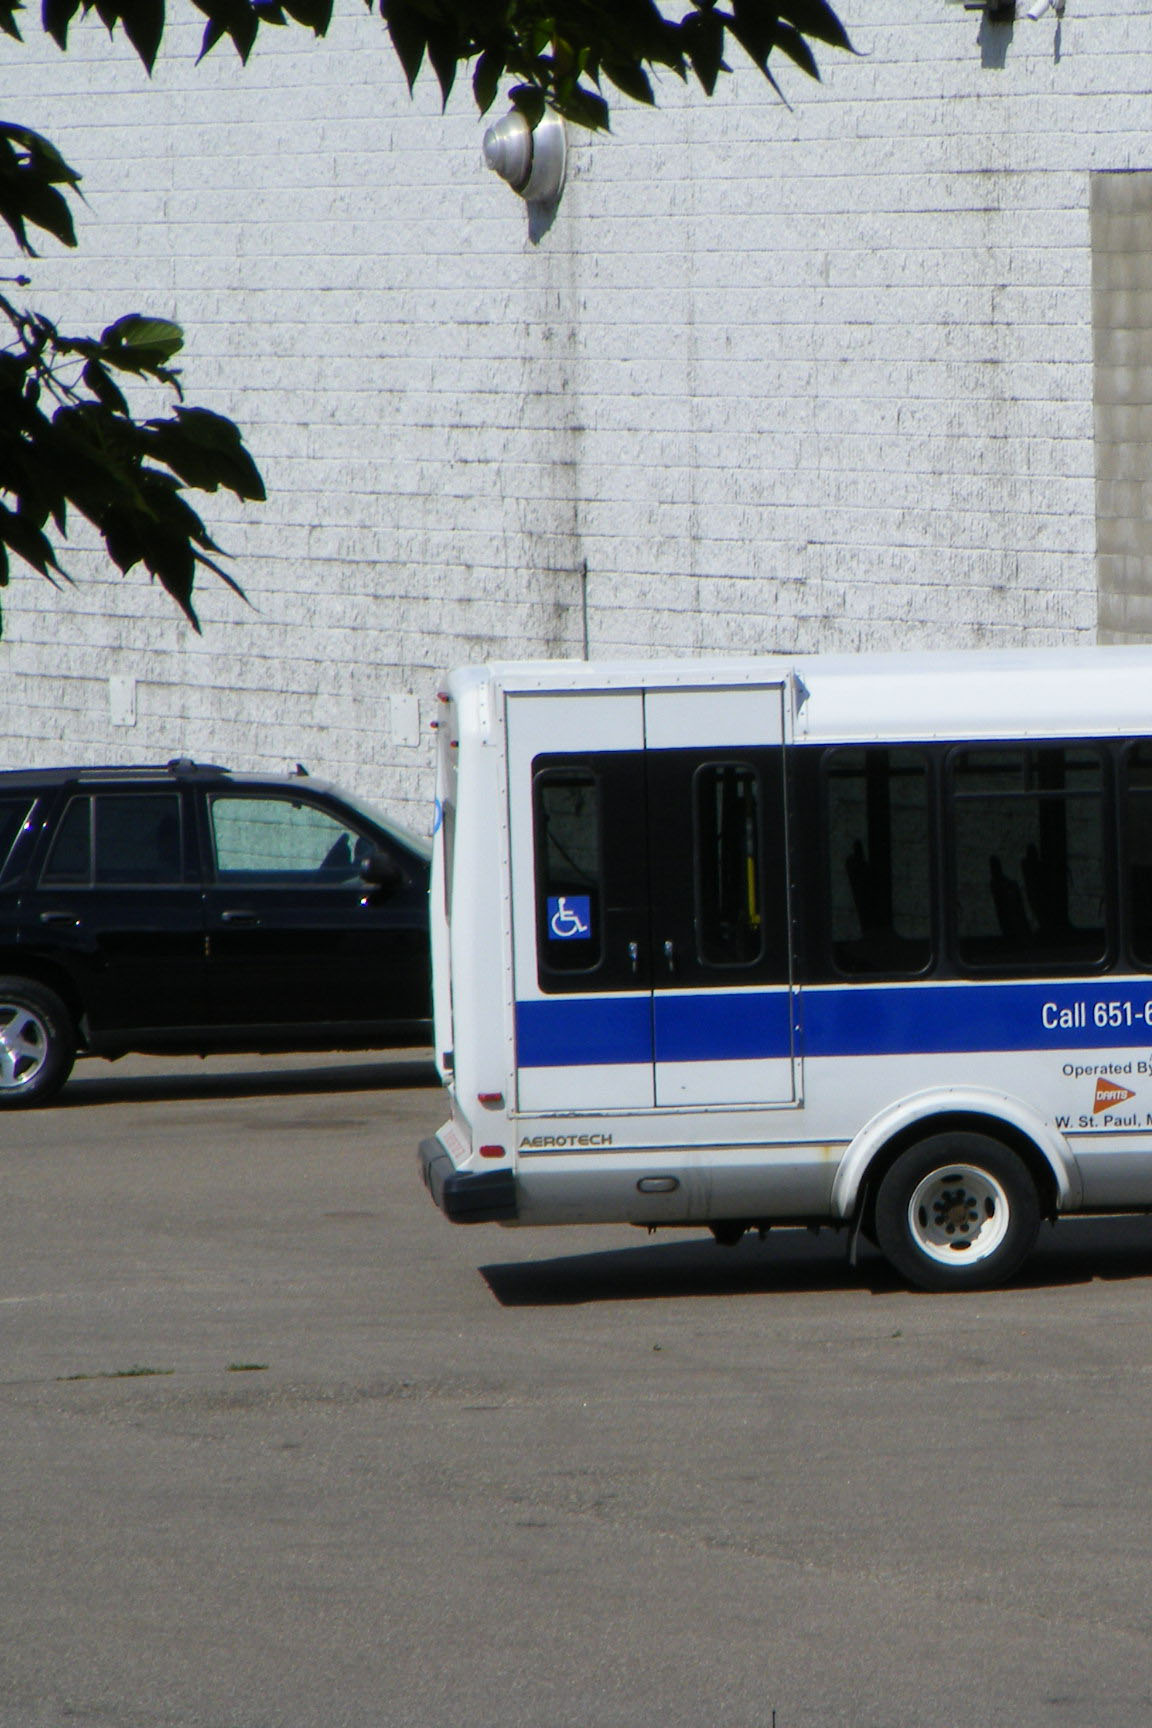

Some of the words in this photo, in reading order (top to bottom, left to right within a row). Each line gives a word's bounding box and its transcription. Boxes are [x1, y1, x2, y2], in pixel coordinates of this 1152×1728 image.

[1041, 1001, 1086, 1029] Call
[1062, 1062, 1132, 1079] Operated
[1096, 1090, 1129, 1101] DARTS
[1055, 1115, 1074, 1129] W.
[1078, 1115, 1098, 1128] St.
[1103, 1113, 1141, 1127] Paul,
[519, 1133, 613, 1148] AEROTECH
